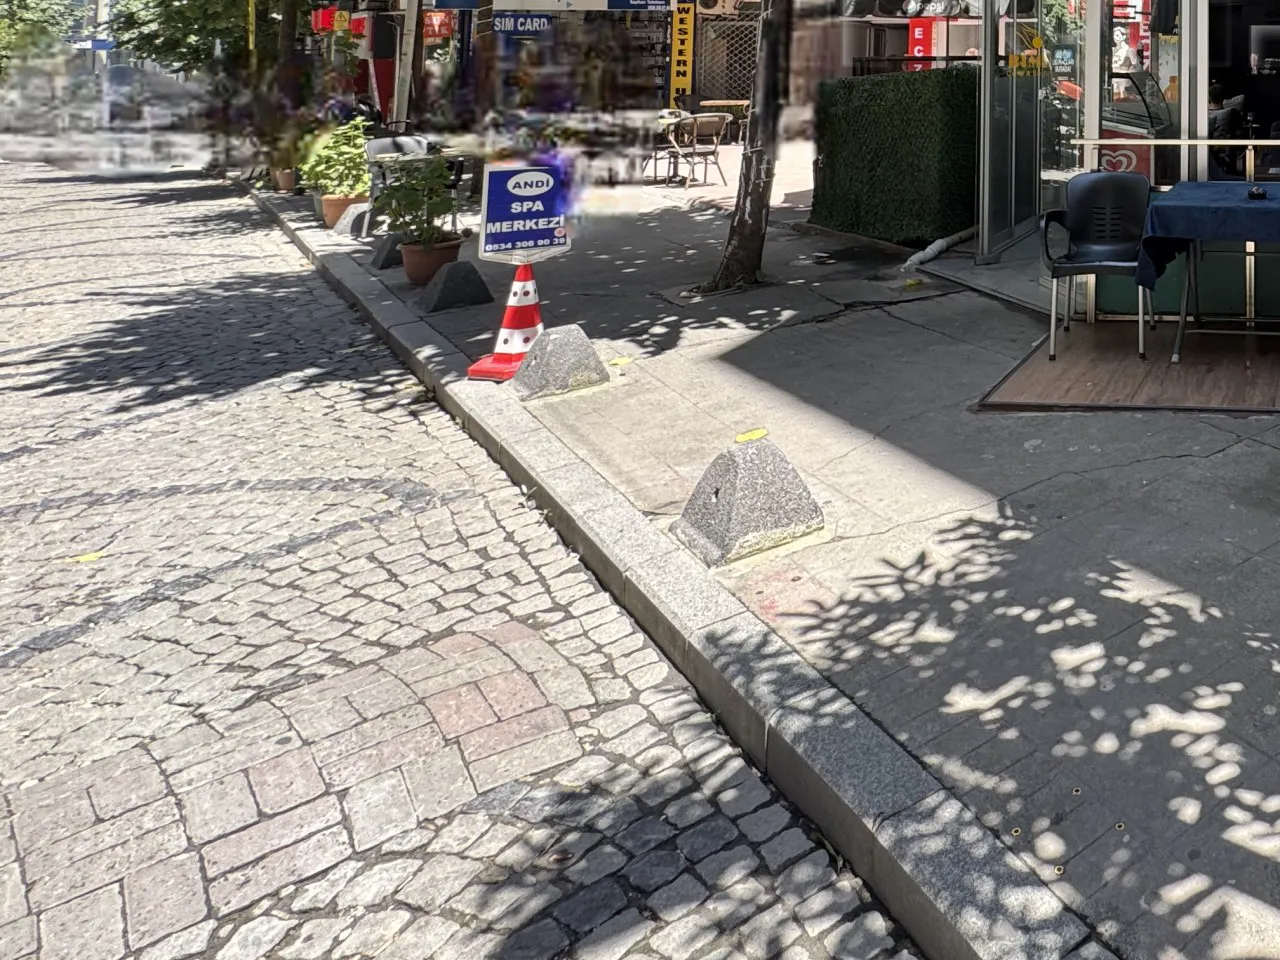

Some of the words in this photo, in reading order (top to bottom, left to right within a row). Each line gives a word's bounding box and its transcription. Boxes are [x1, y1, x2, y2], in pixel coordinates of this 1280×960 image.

[917, 1, 946, 13] pepsi
[494, 17, 514, 31] SIM
[517, 17, 548, 31] CARD
[675, 7, 690, 77] WESTERN
[510, 200, 545, 213] SPA
